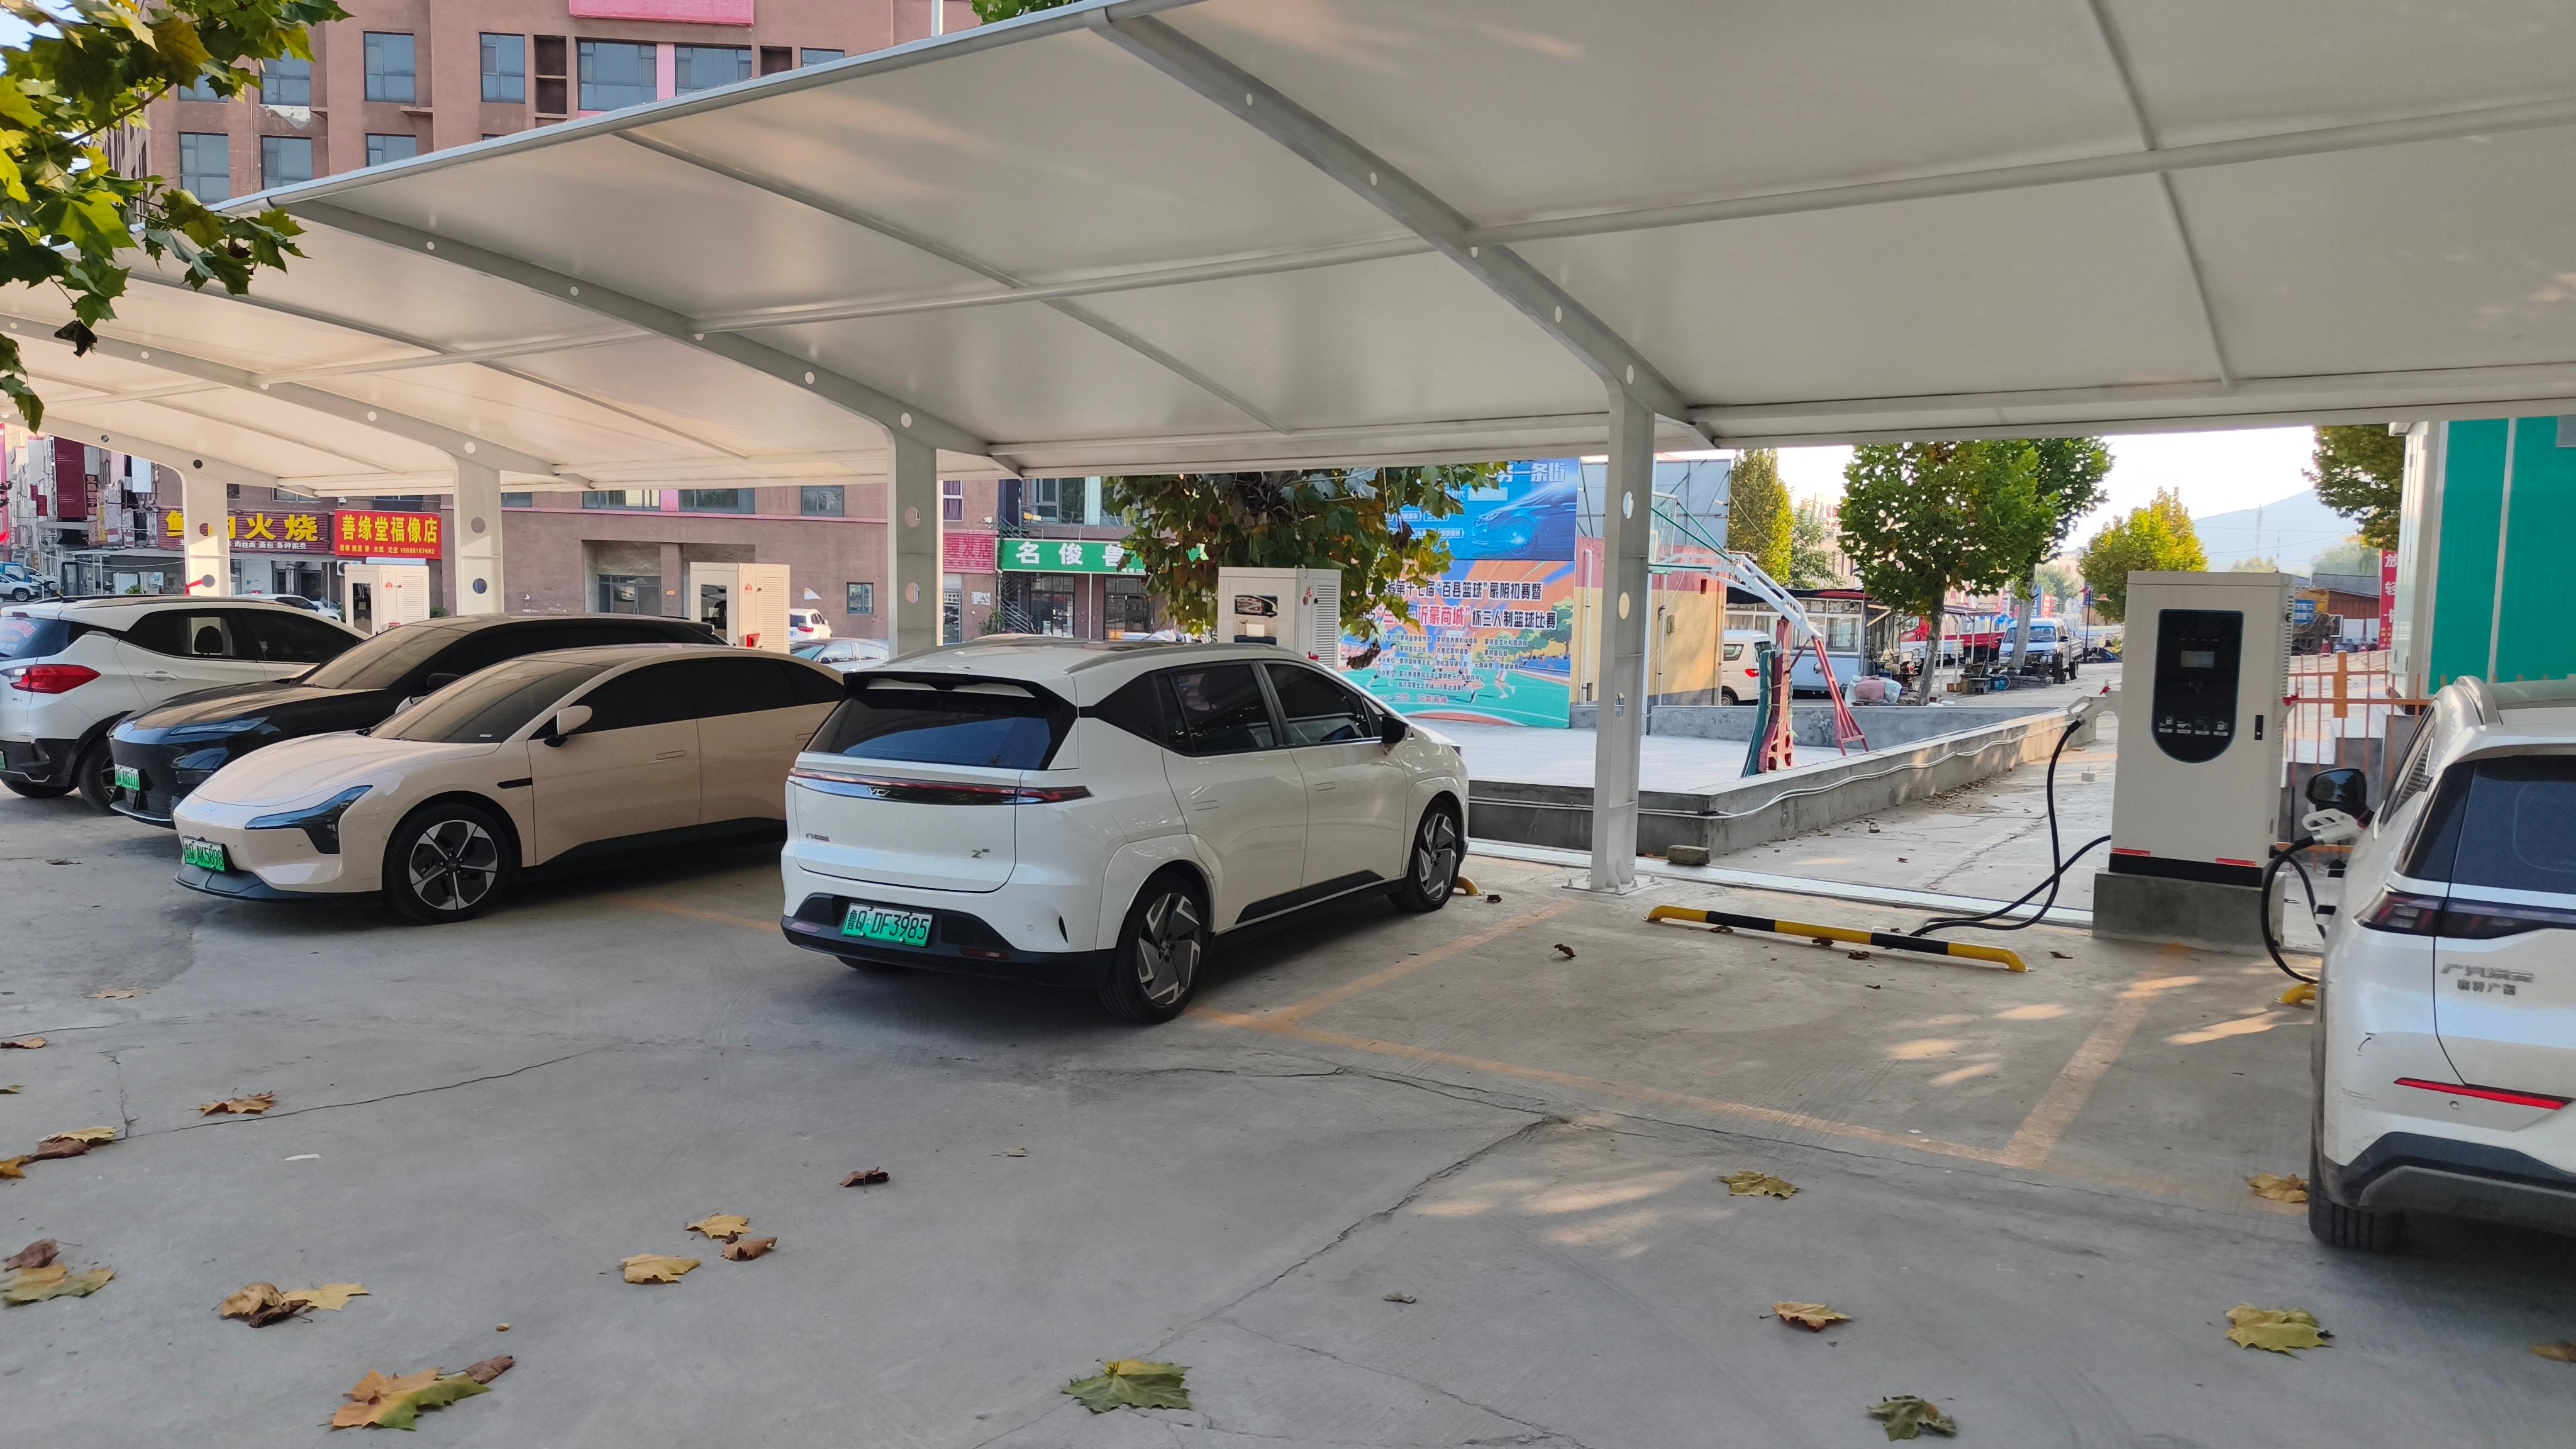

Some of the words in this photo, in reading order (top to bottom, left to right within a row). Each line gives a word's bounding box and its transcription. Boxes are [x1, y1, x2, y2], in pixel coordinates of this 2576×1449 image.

[341, 514, 438, 543] 善缘堂福像店
